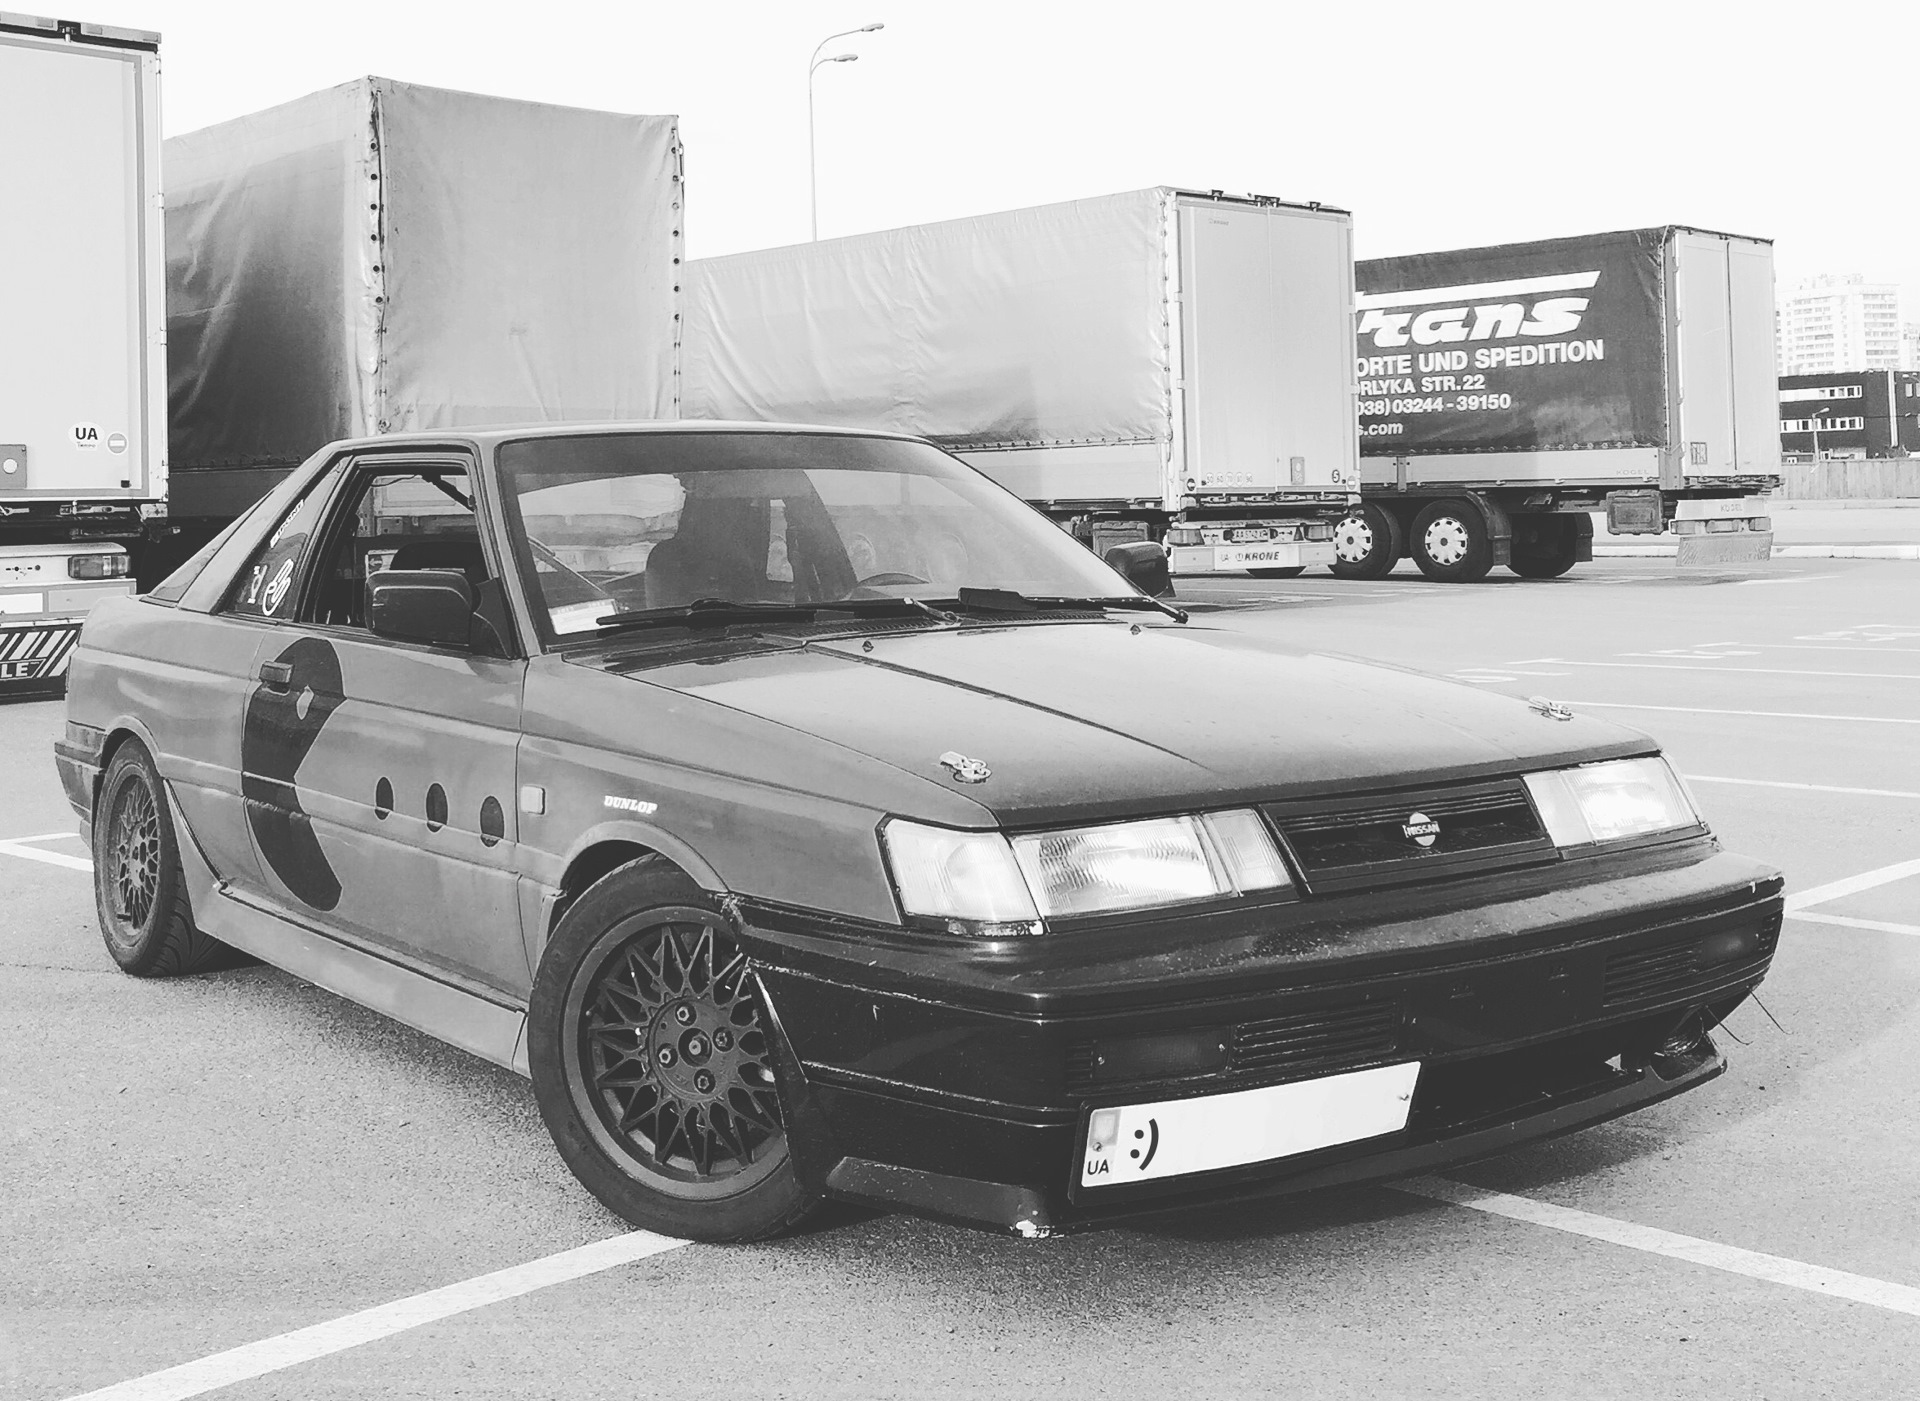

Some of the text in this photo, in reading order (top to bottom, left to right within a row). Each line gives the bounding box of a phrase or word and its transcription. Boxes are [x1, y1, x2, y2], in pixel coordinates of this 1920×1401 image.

[1357, 339, 1604, 377] ORTE UND SPEDITION
[1358, 374, 1486, 396] RLYKA STR.22
[1456, 394, 1511, 412] 39150
[75, 427, 98, 440] UA
[1244, 551, 1280, 561] KRONE
[604, 795, 658, 814] DUNLOP
[1405, 822, 1440, 836] NISSAN
[1087, 1159, 1110, 1176] UA
